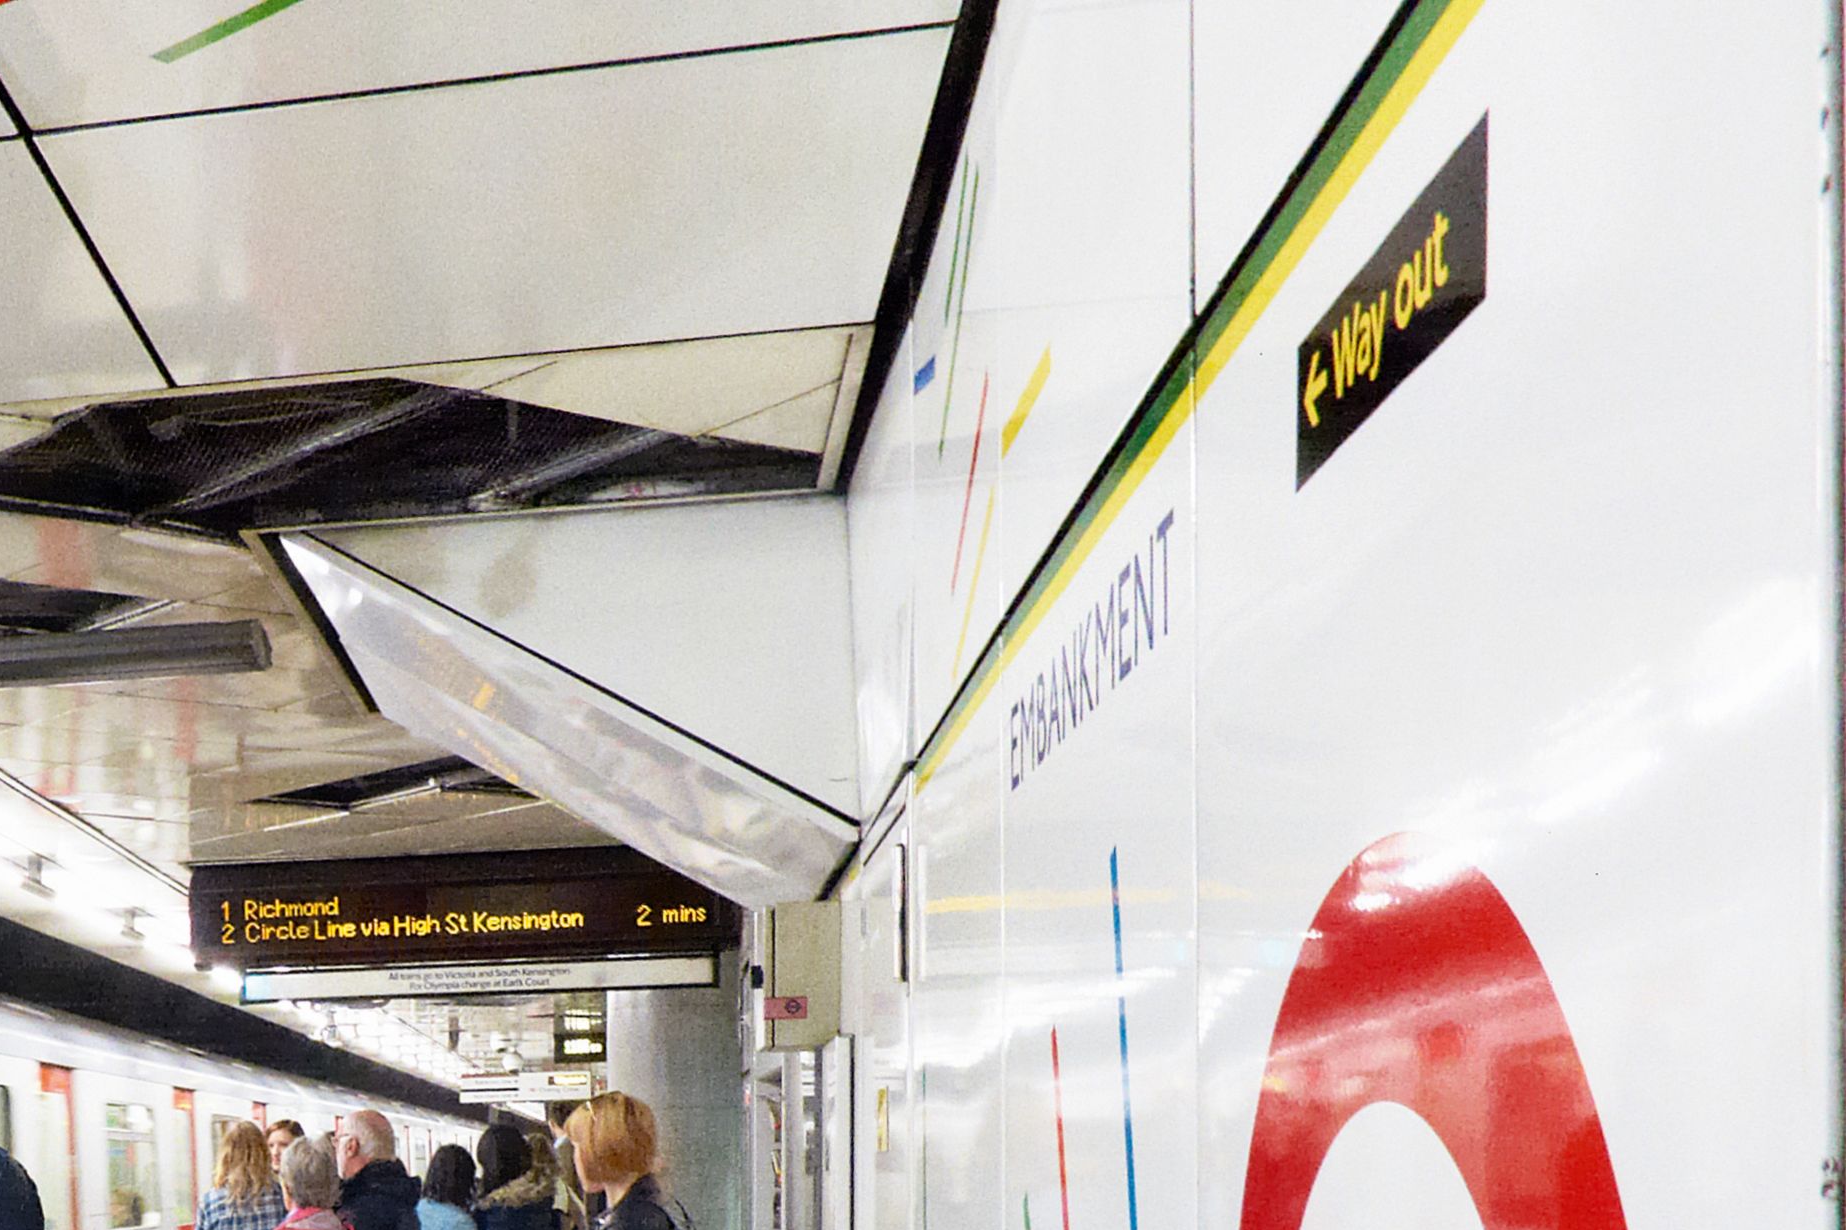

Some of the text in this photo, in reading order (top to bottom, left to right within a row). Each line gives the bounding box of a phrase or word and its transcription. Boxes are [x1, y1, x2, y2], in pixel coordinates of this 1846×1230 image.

[1331, 211, 1450, 400] Way out
[1009, 507, 1175, 792] EMBANKMENT
[220, 896, 340, 922] 1 Richmond
[221, 904, 707, 944] 2 Circle Line via High St Kensington 2 mins
[444, 970, 475, 979] Victoria
[478, 969, 494, 978] and
[495, 968, 520, 977] South
[522, 967, 571, 977] Kensington
[461, 979, 491, 989] change
[525, 977, 550, 987] Court
